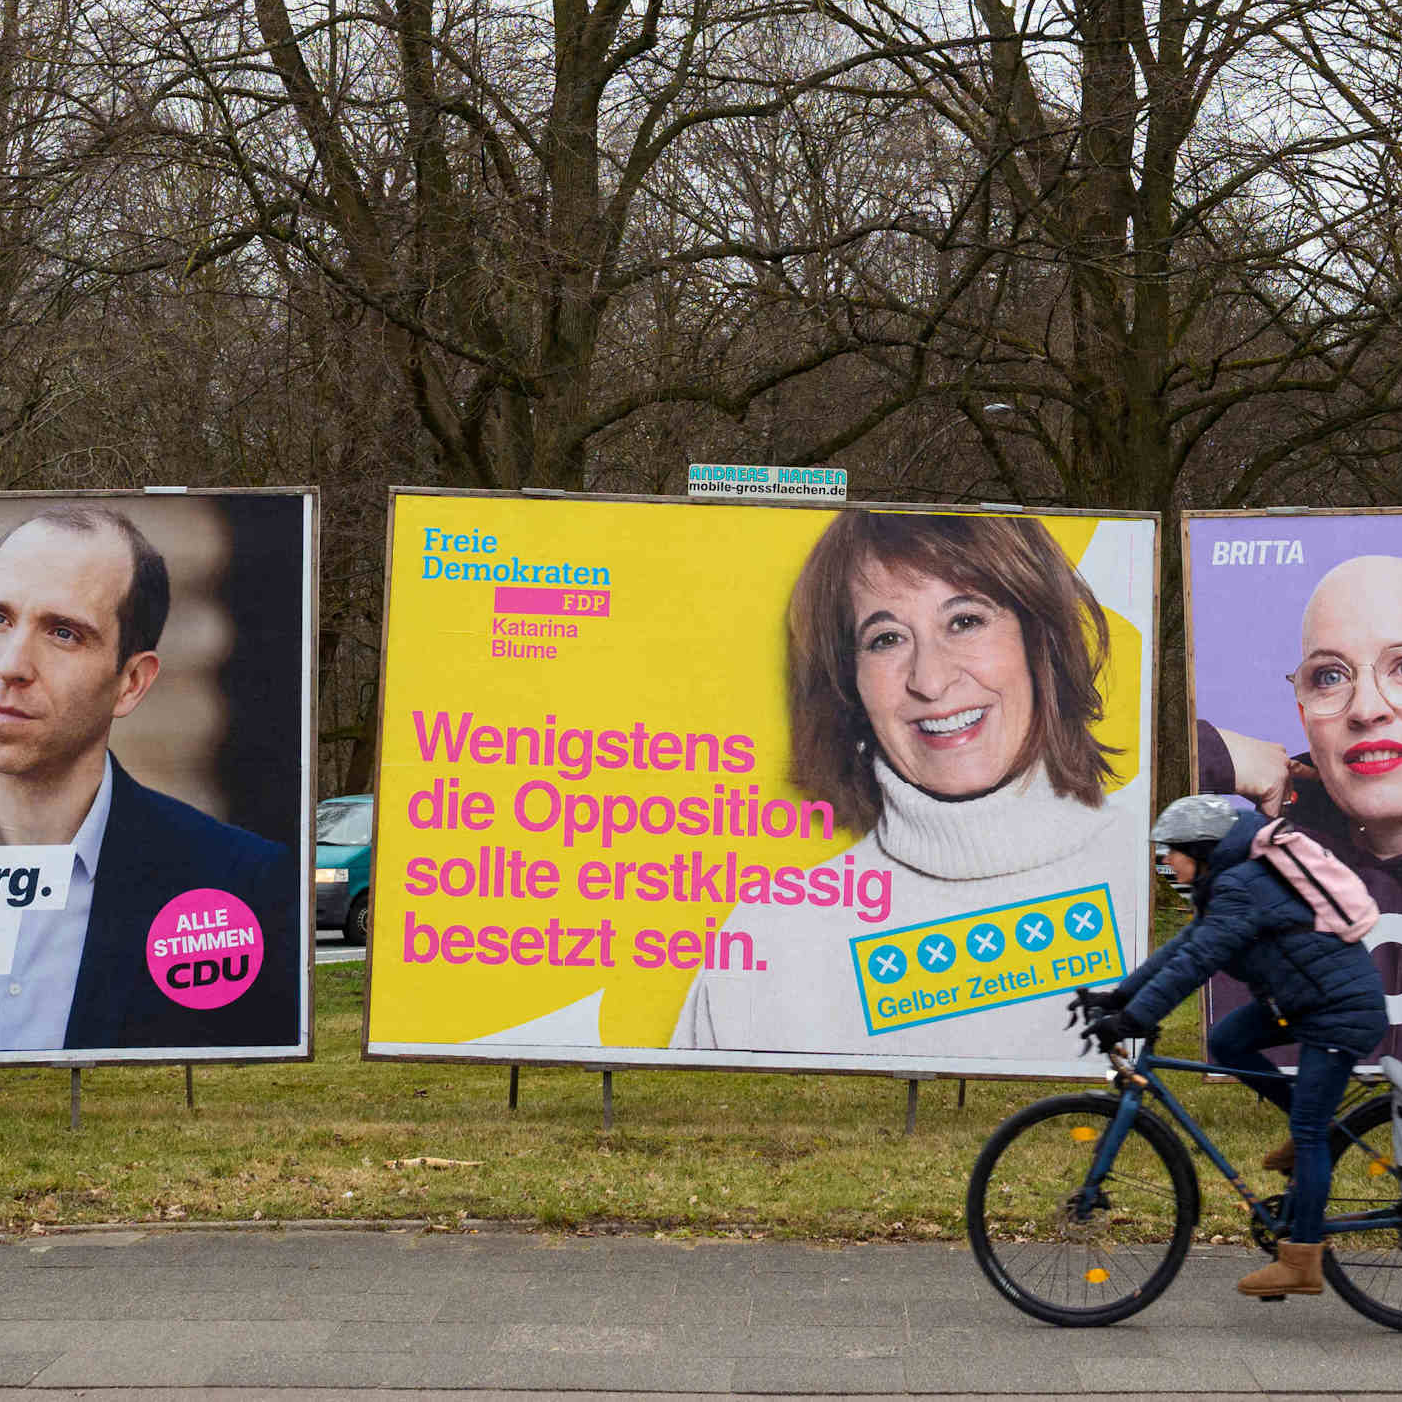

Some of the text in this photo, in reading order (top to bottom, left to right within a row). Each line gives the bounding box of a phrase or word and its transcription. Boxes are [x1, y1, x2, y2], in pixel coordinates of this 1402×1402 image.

[689, 466, 846, 485] ANDREAS HANSEN
[689, 482, 846, 495] mobile-grossflaechen.de
[423, 527, 498, 555] Freie
[1212, 540, 1304, 566] BRITTA
[422, 555, 611, 585] Demokraten
[562, 592, 606, 612] FDP
[492, 618, 578, 639] Katarina
[492, 640, 558, 660] Blume
[412, 710, 756, 780] Wenigstens
[408, 779, 834, 847] die Opposition
[405, 847, 893, 924] sollte erstklassig
[176, 909, 228, 931] ALLE
[153, 927, 255, 958] STIMMEN
[402, 911, 767, 973] besetzt sein.
[165, 955, 250, 989] CDU
[877, 948, 1112, 1020] Gelber Zettel. FDP!
